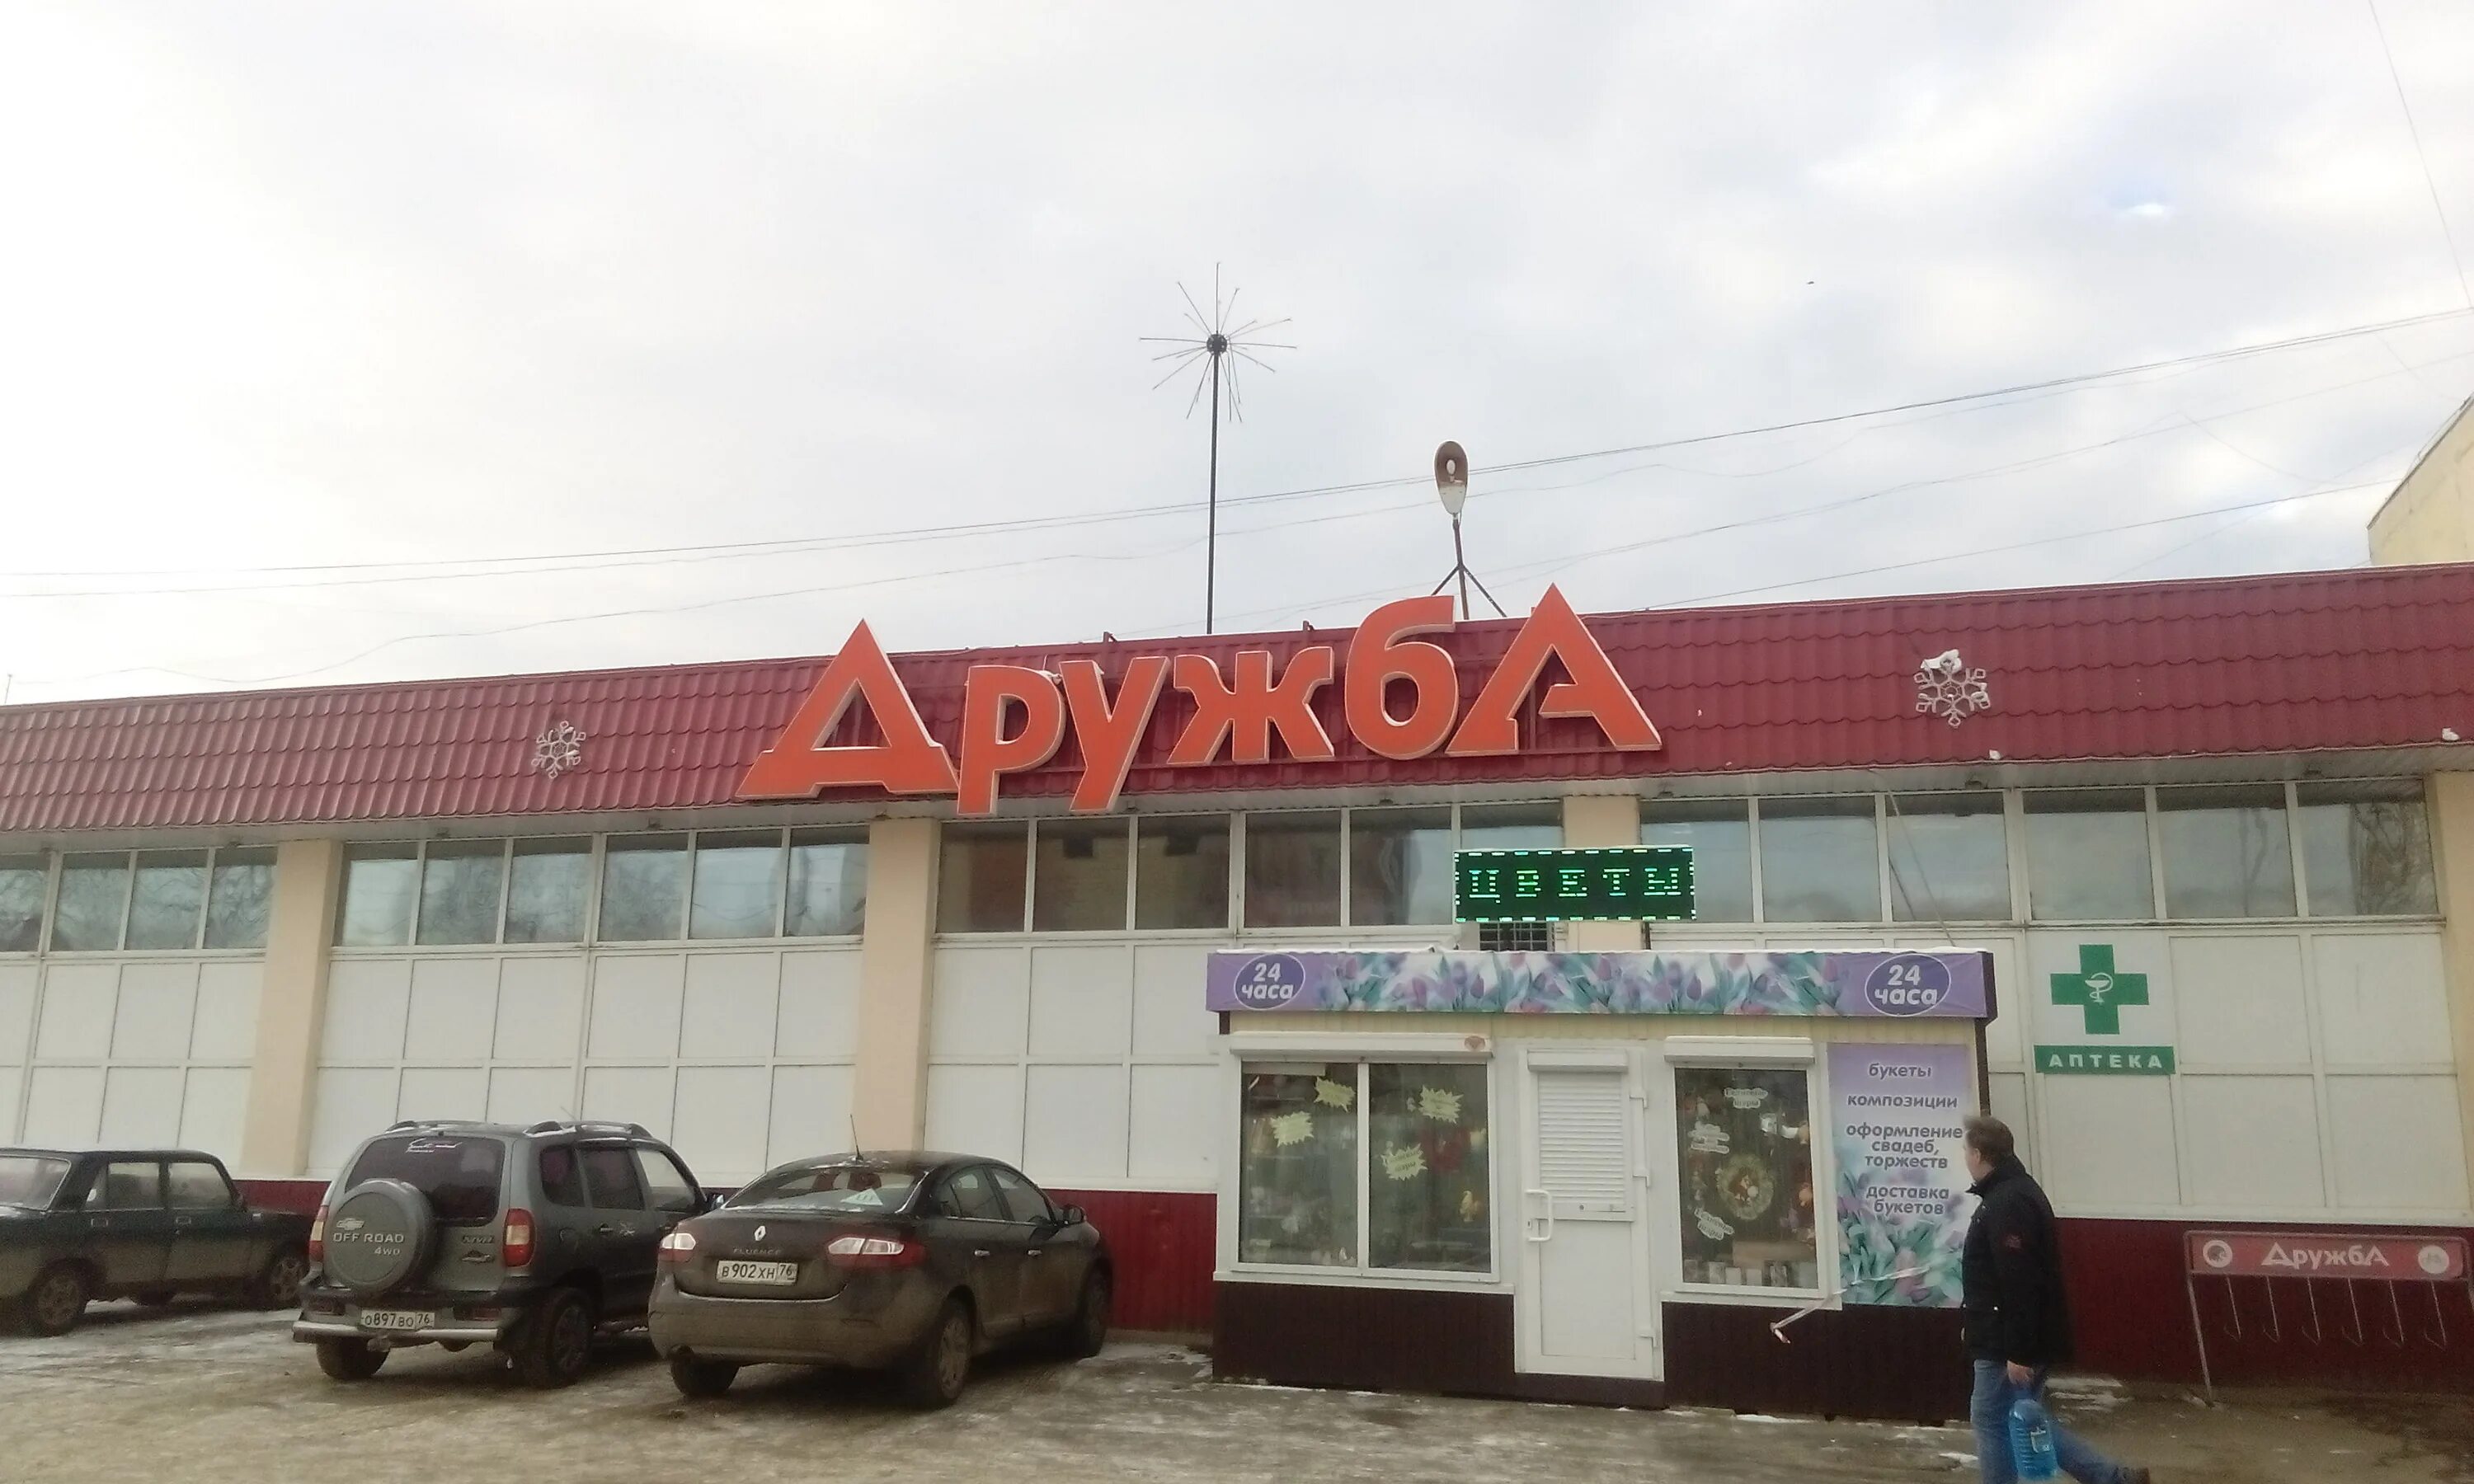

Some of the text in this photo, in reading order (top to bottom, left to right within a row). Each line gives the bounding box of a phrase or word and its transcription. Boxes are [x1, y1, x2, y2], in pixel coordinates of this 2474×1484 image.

[1469, 868, 1681, 904] ЦВЕТЫ
[1253, 962, 1282, 982] 24
[1887, 965, 1921, 985] 24
[1241, 984, 1294, 999] часа
[1874, 989, 1938, 1005] часа
[2048, 1054, 2162, 1068] АПТЕКА
[1869, 1063, 1931, 1079] букеты
[1847, 1095, 1958, 1109] композиции
[1846, 1122, 1963, 1139] оформление
[1871, 1139, 1940, 1155] свадеб,
[1865, 1155, 1948, 1170] торжеств
[1866, 1186, 1950, 1200] доставка
[1874, 1200, 1945, 1216] букетов
[333, 1233, 405, 1243] OFF ROAD
[374, 1246, 401, 1256] 4WD
[722, 1263, 793, 1279] В902ХН 76
[365, 1313, 430, 1327] О897ВО 76
